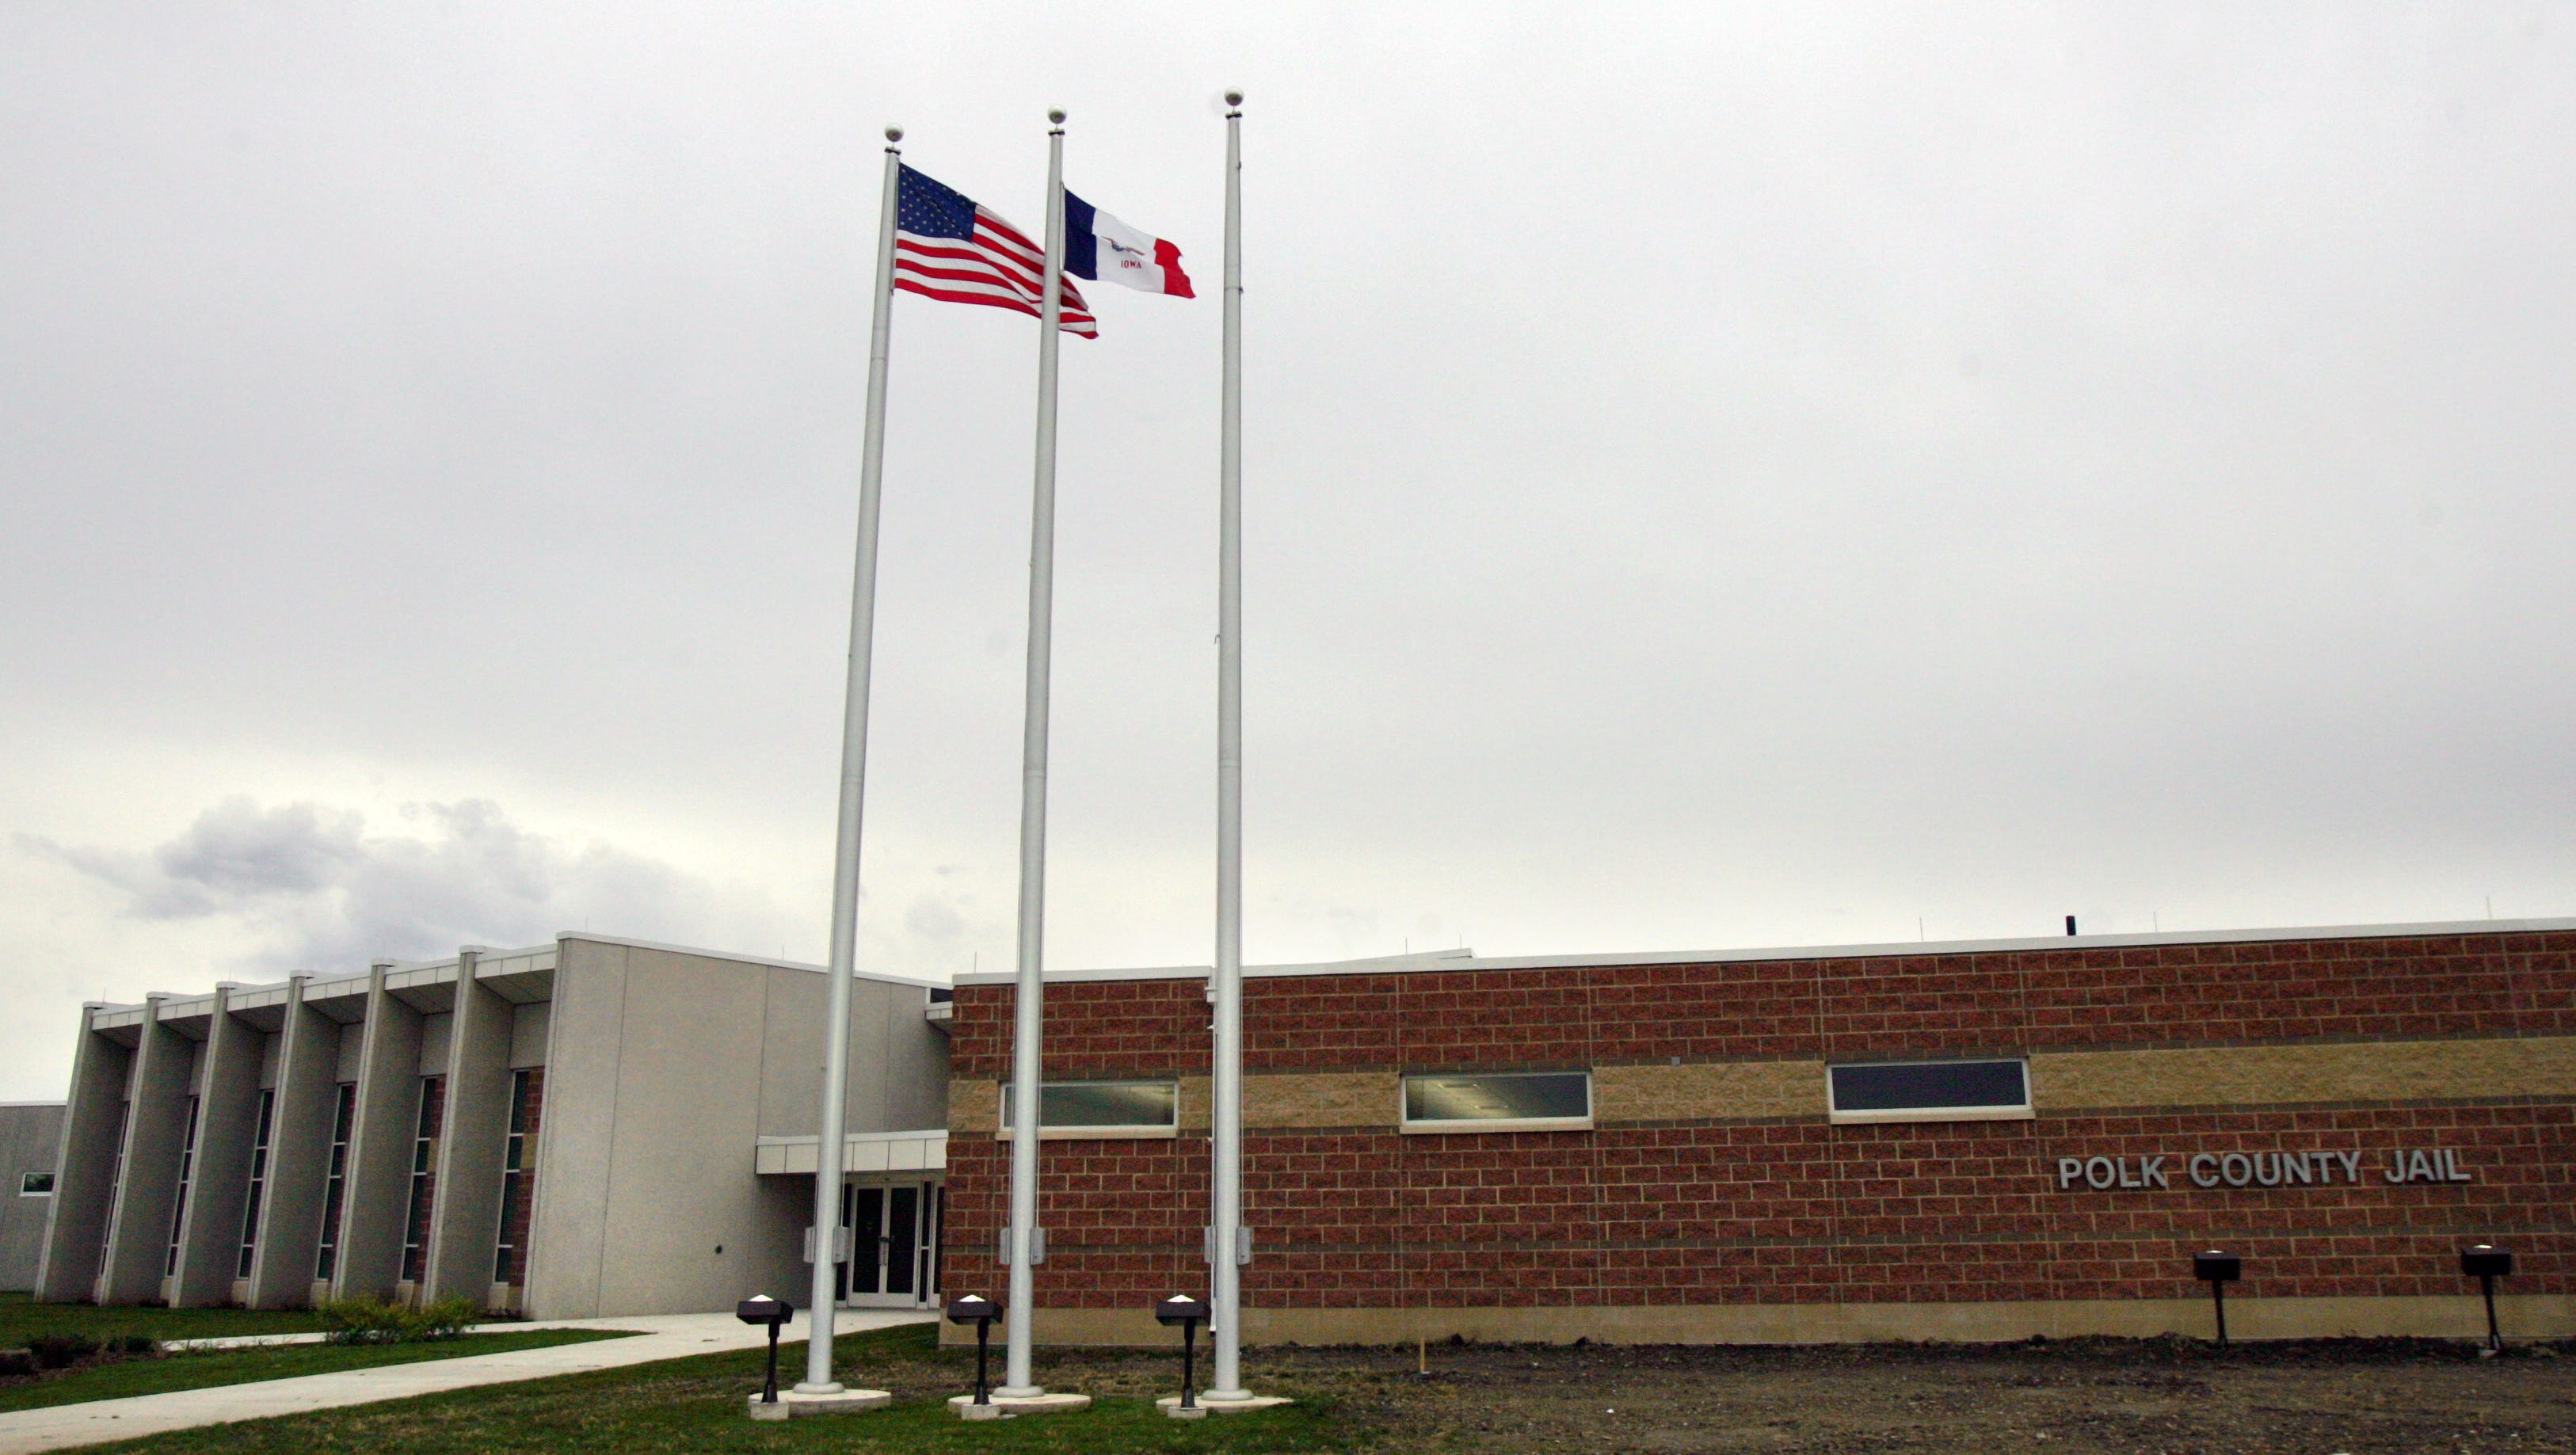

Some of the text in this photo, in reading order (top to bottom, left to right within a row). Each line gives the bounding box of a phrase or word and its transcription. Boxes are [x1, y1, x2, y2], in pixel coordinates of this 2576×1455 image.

[1121, 260, 1141, 269] IOWA
[2059, 1149, 2472, 1189] POLK COUNTY JAIL
